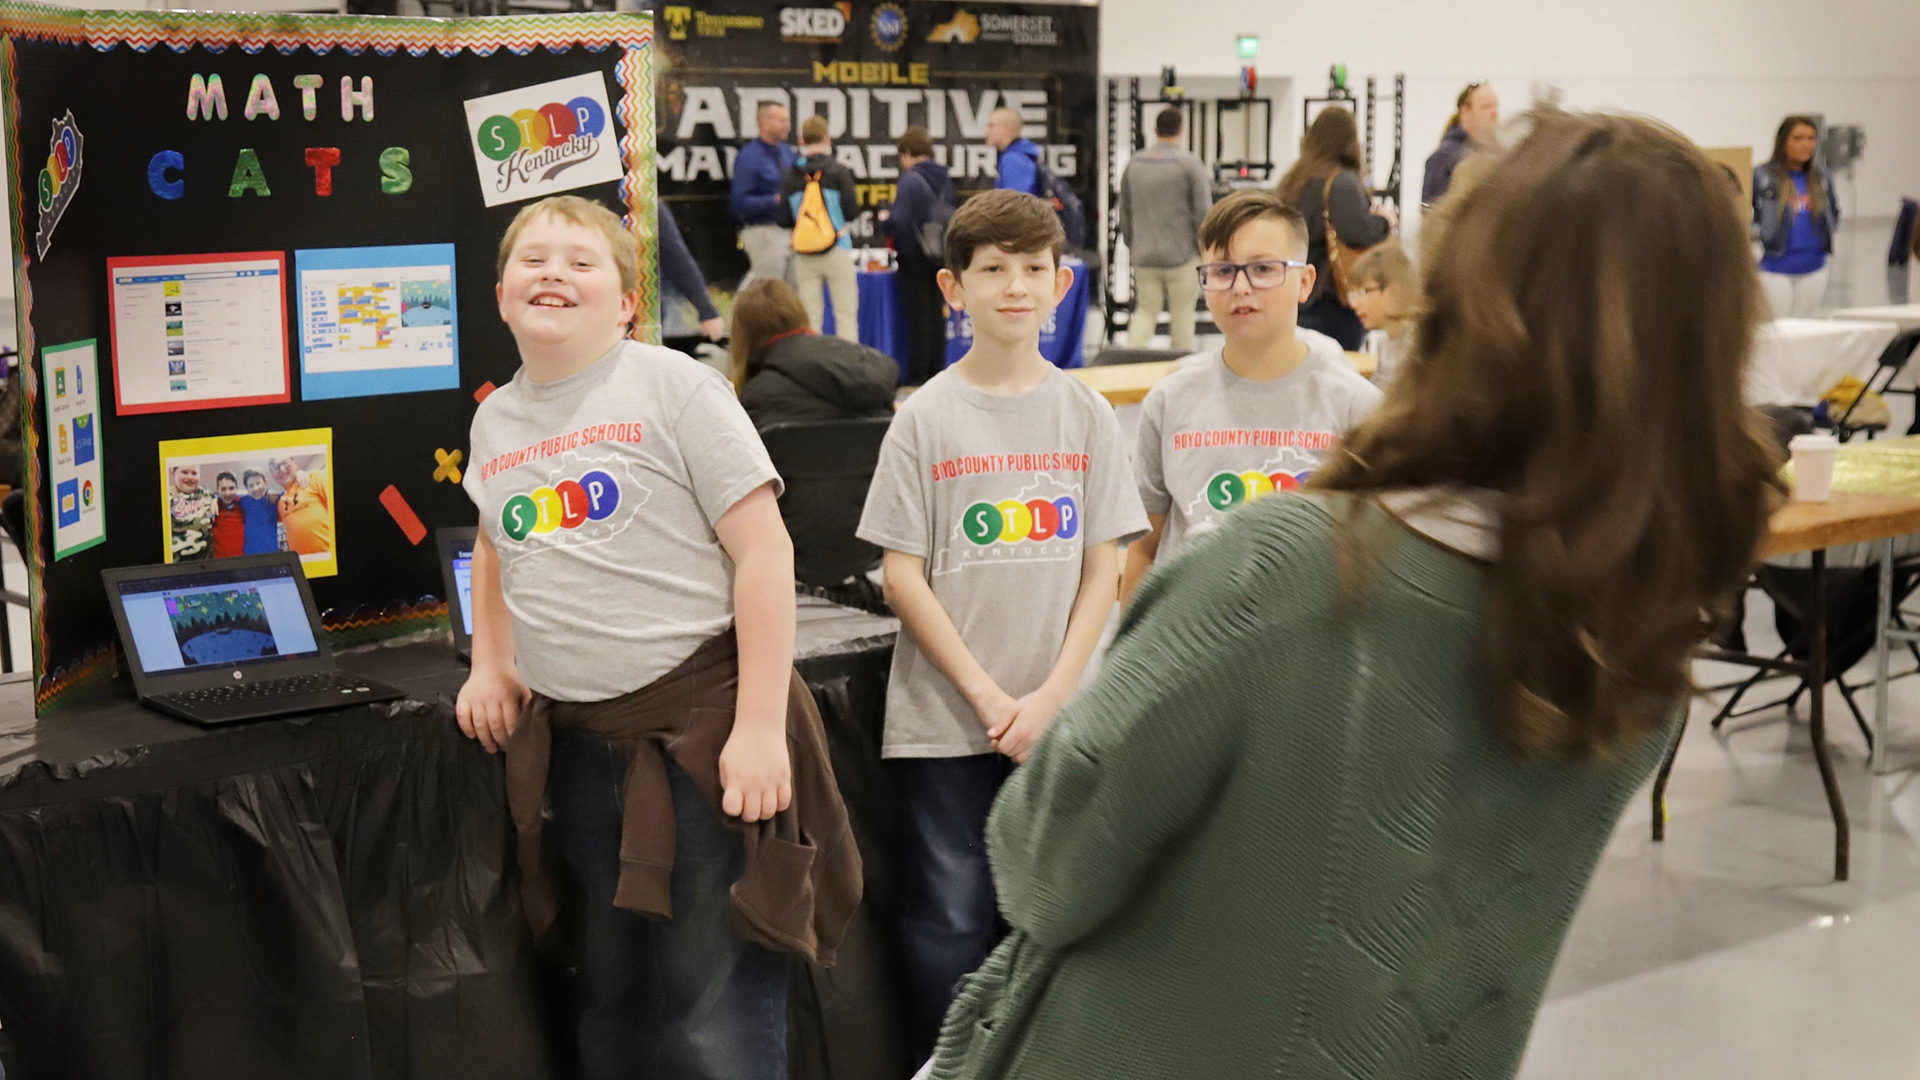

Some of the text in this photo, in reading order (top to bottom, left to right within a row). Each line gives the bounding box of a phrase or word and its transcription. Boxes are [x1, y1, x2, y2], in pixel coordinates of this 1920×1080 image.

[780, 7, 846, 36] SKED
[813, 60, 929, 84] MOBILE
[187, 73, 374, 122] MATH
[490, 107, 590, 151] STLP
[147, 147, 413, 199] CATS
[496, 133, 600, 192] Kentucky
[499, 443, 539, 472] COUNTY
[541, 431, 579, 459] PUBLIC
[581, 422, 643, 447] SCHOOLS
[1174, 429, 1333, 450] BOYD COUNTY PUBLIC SCHO
[957, 454, 1005, 475] COUNTY
[1008, 453, 1051, 472] PUBLIC
[511, 480, 604, 533] STLP
[976, 504, 1073, 538] STLP
